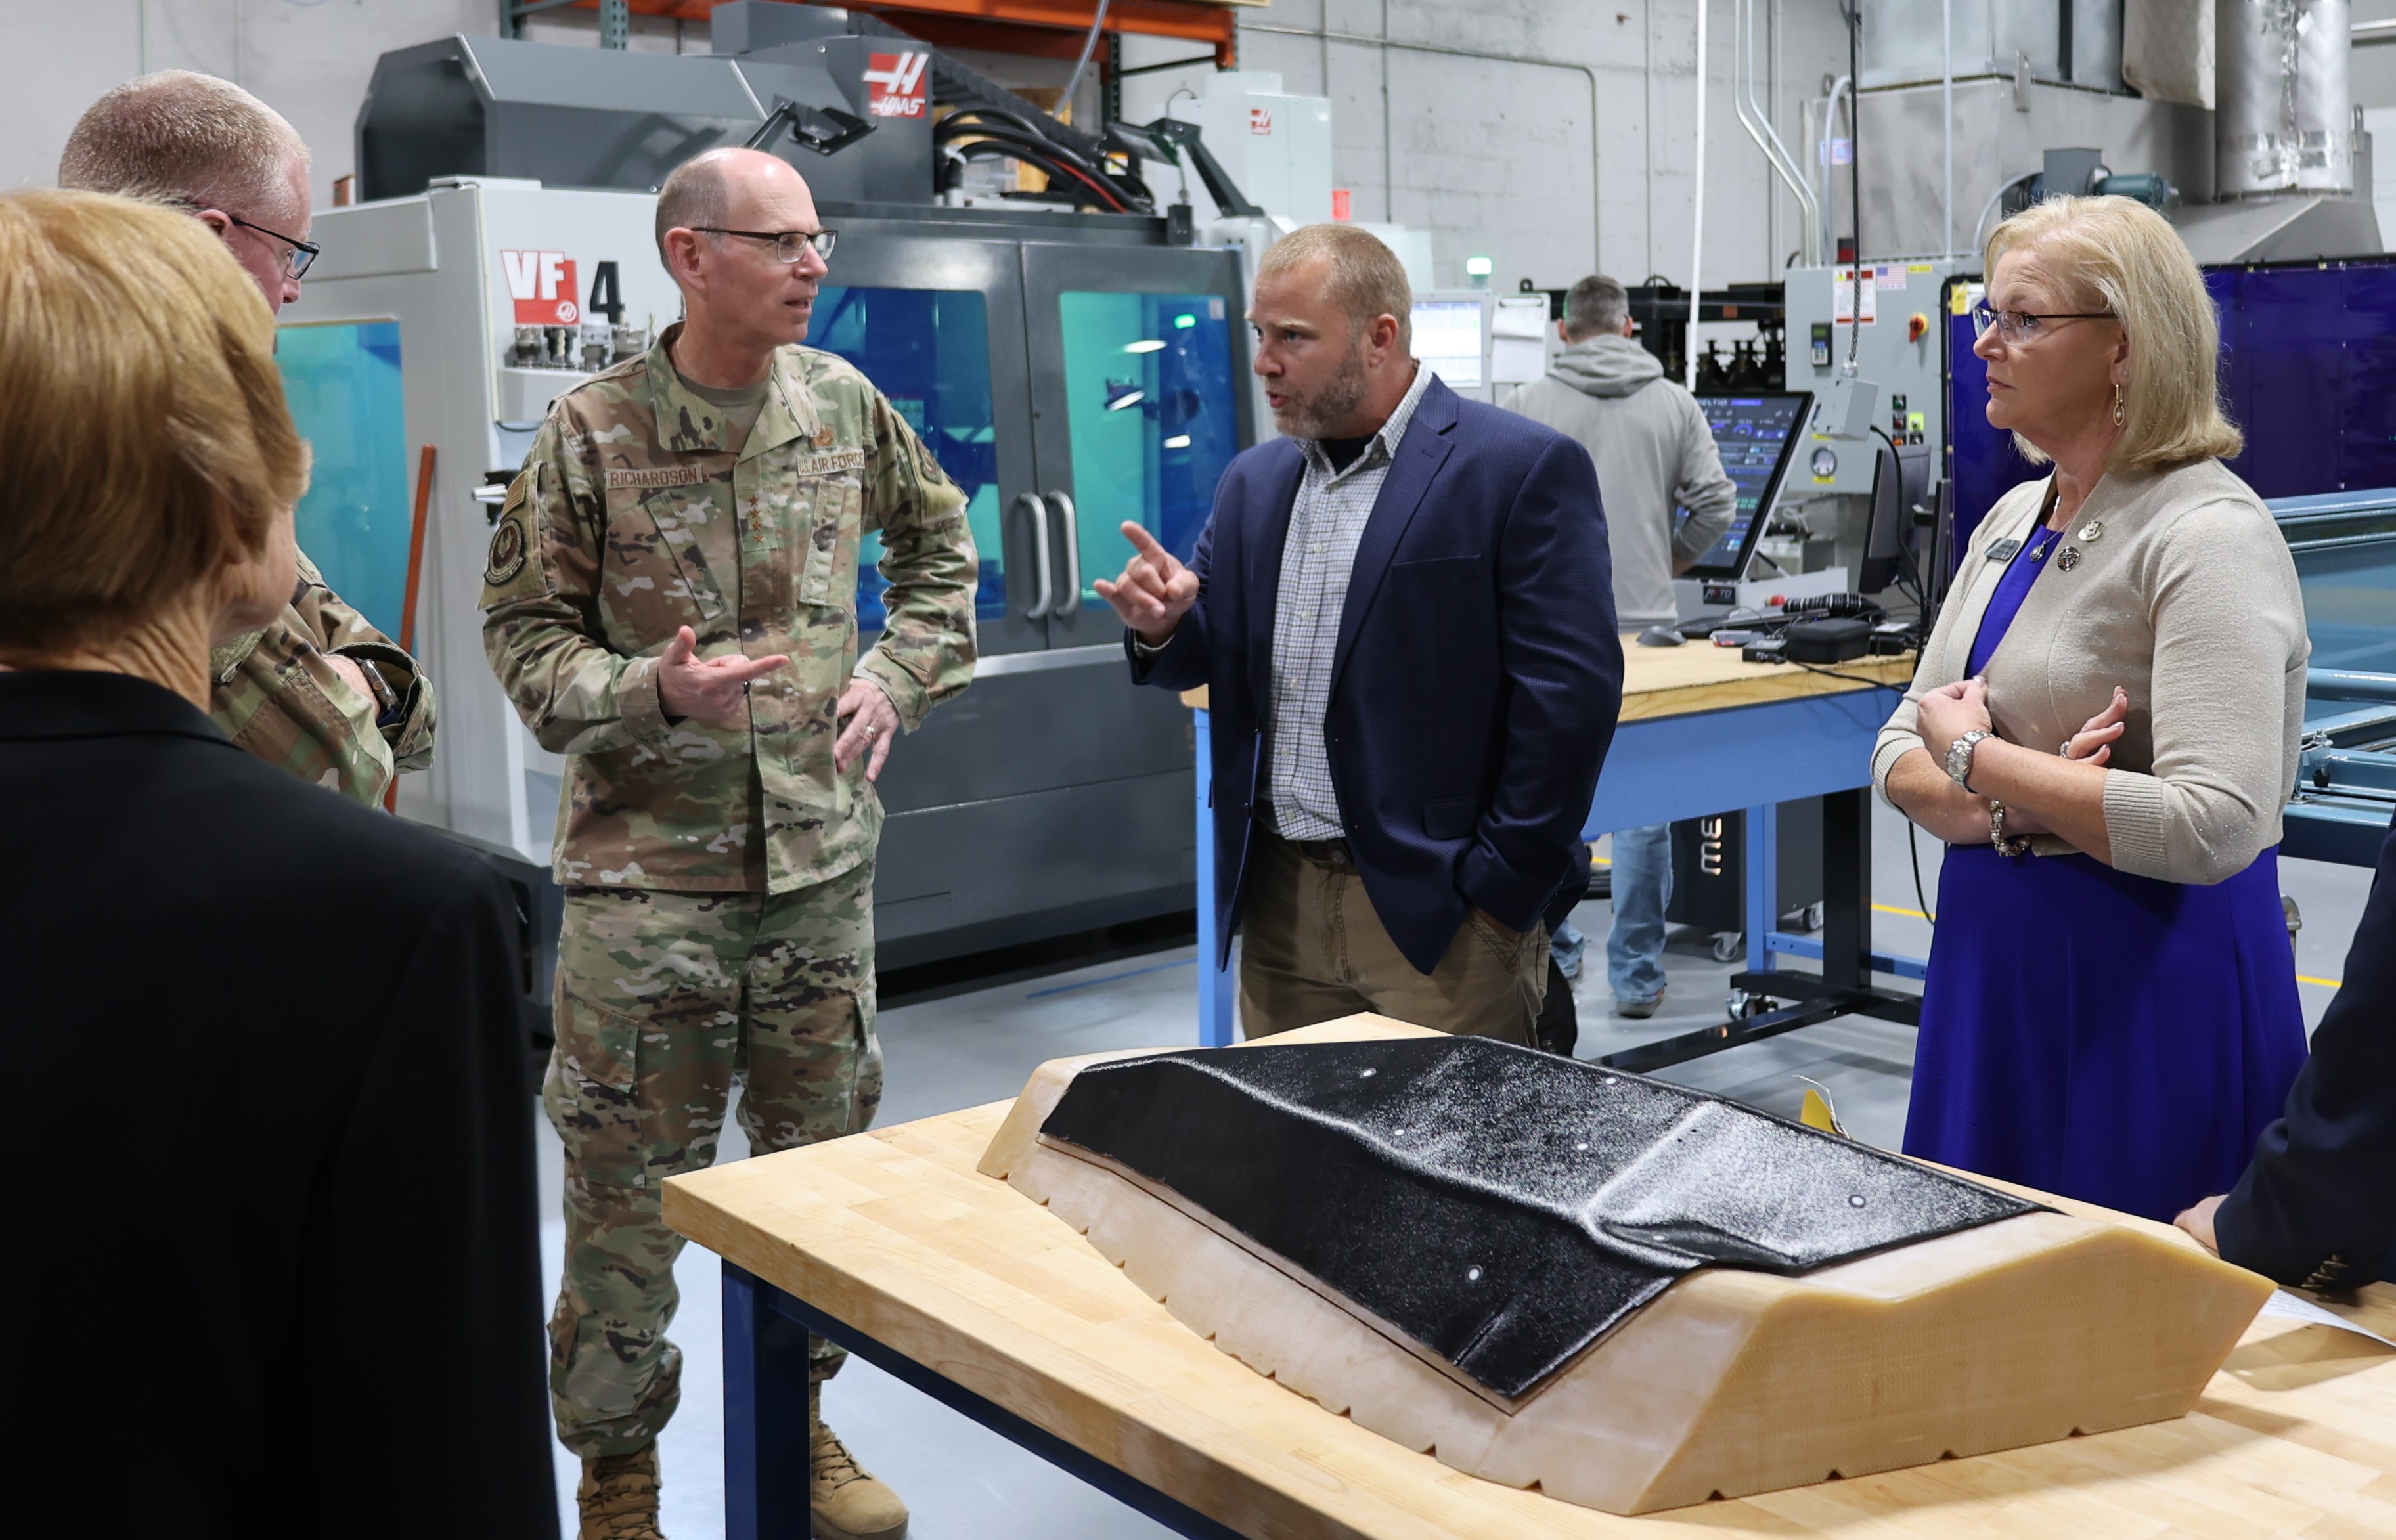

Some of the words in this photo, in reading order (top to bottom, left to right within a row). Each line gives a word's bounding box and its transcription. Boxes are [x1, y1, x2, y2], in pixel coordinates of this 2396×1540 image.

[870, 95, 926, 116] HAAS
[500, 250, 566, 301] VF
[590, 260, 624, 324] 4
[799, 457, 810, 473] U.S.
[812, 456, 829, 473] AIR
[830, 452, 864, 470] FORCE
[610, 468, 698, 487] RICHARDSON
